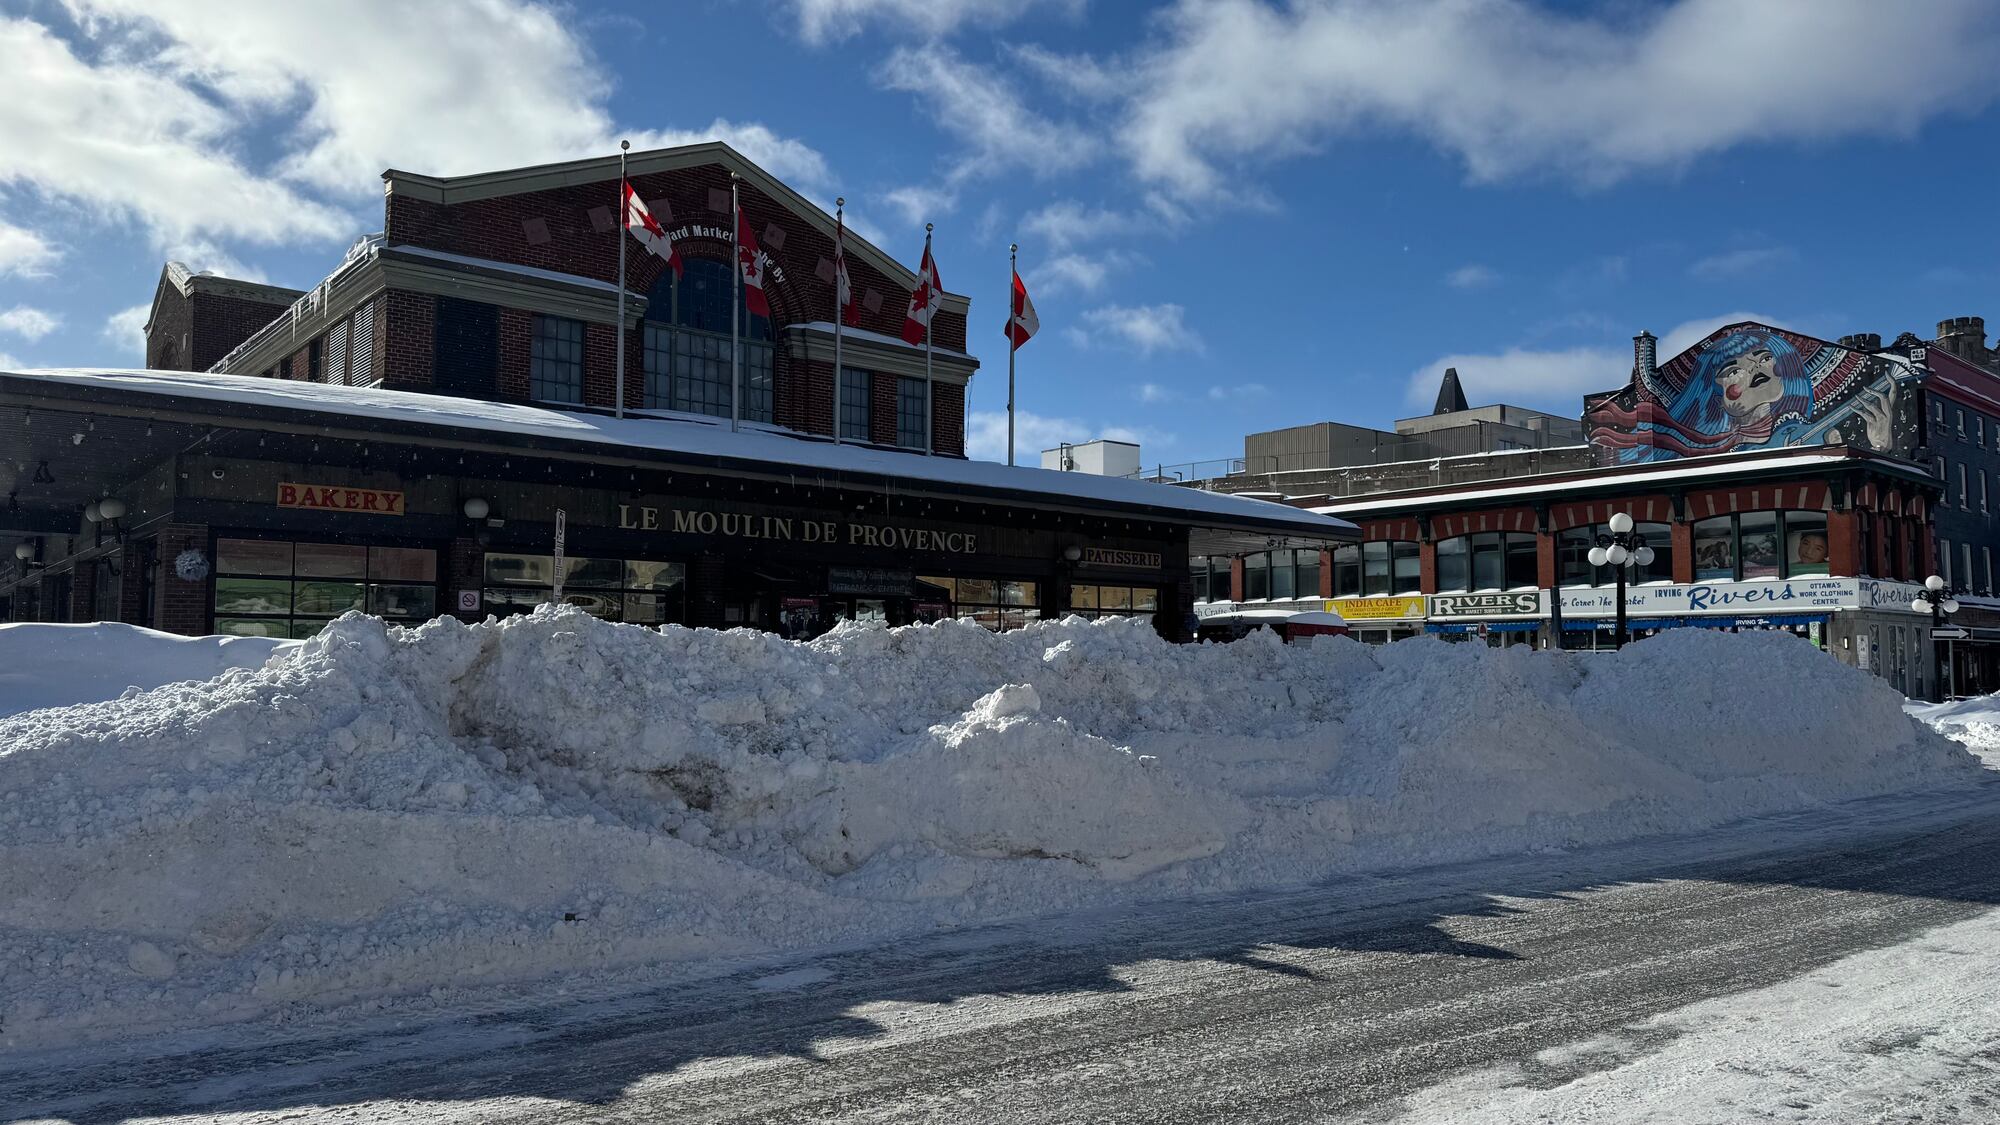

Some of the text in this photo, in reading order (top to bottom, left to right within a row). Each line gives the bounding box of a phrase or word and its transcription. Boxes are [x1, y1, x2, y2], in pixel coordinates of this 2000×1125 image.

[772, 266, 786, 283] By
[280, 485, 402, 512] BAKERY
[618, 504, 977, 554] LE MOULIN DE PROVENCE
[1087, 549, 1160, 566] PATISSERIE
[1345, 600, 1372, 608] INDIA
[1433, 594, 1537, 615] RIVERS
[1572, 597, 1594, 606] Corner
[1599, 596, 1612, 606] The
[1625, 596, 1646, 605] arket
[1655, 584, 1796, 610] IRVING Rivers
